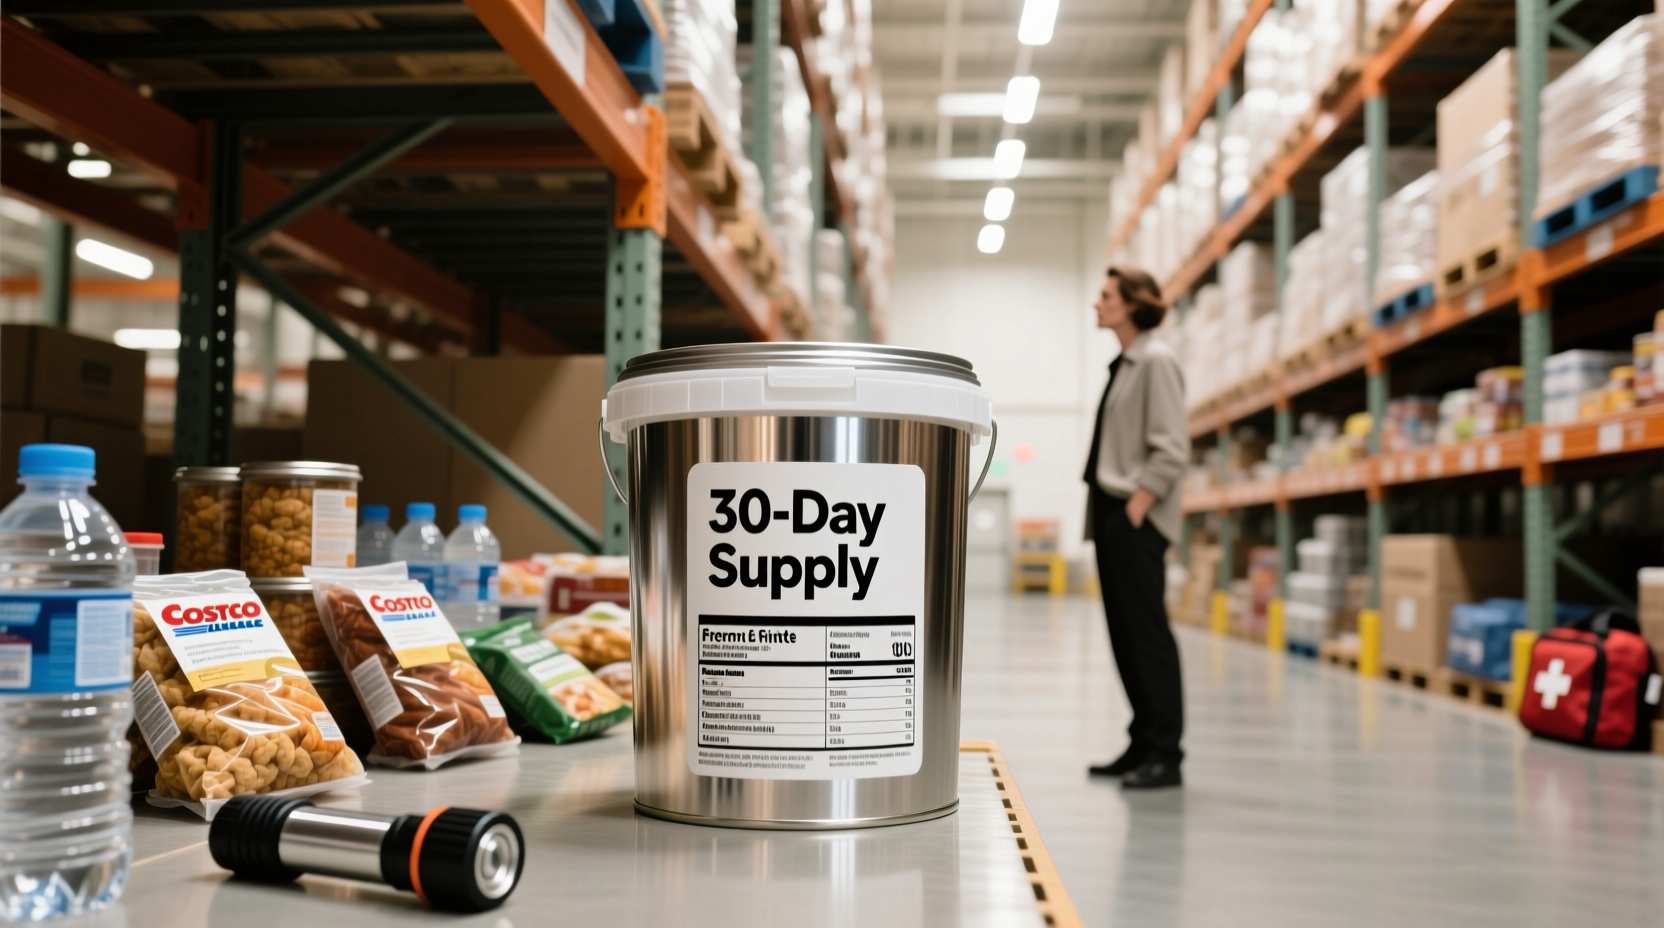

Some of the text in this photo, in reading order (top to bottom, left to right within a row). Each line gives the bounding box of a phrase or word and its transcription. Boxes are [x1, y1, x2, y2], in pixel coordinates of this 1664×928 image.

[708, 488, 887, 547] 30-Day
[708, 542, 880, 601] Supply
[161, 601, 261, 626] COSTCO
